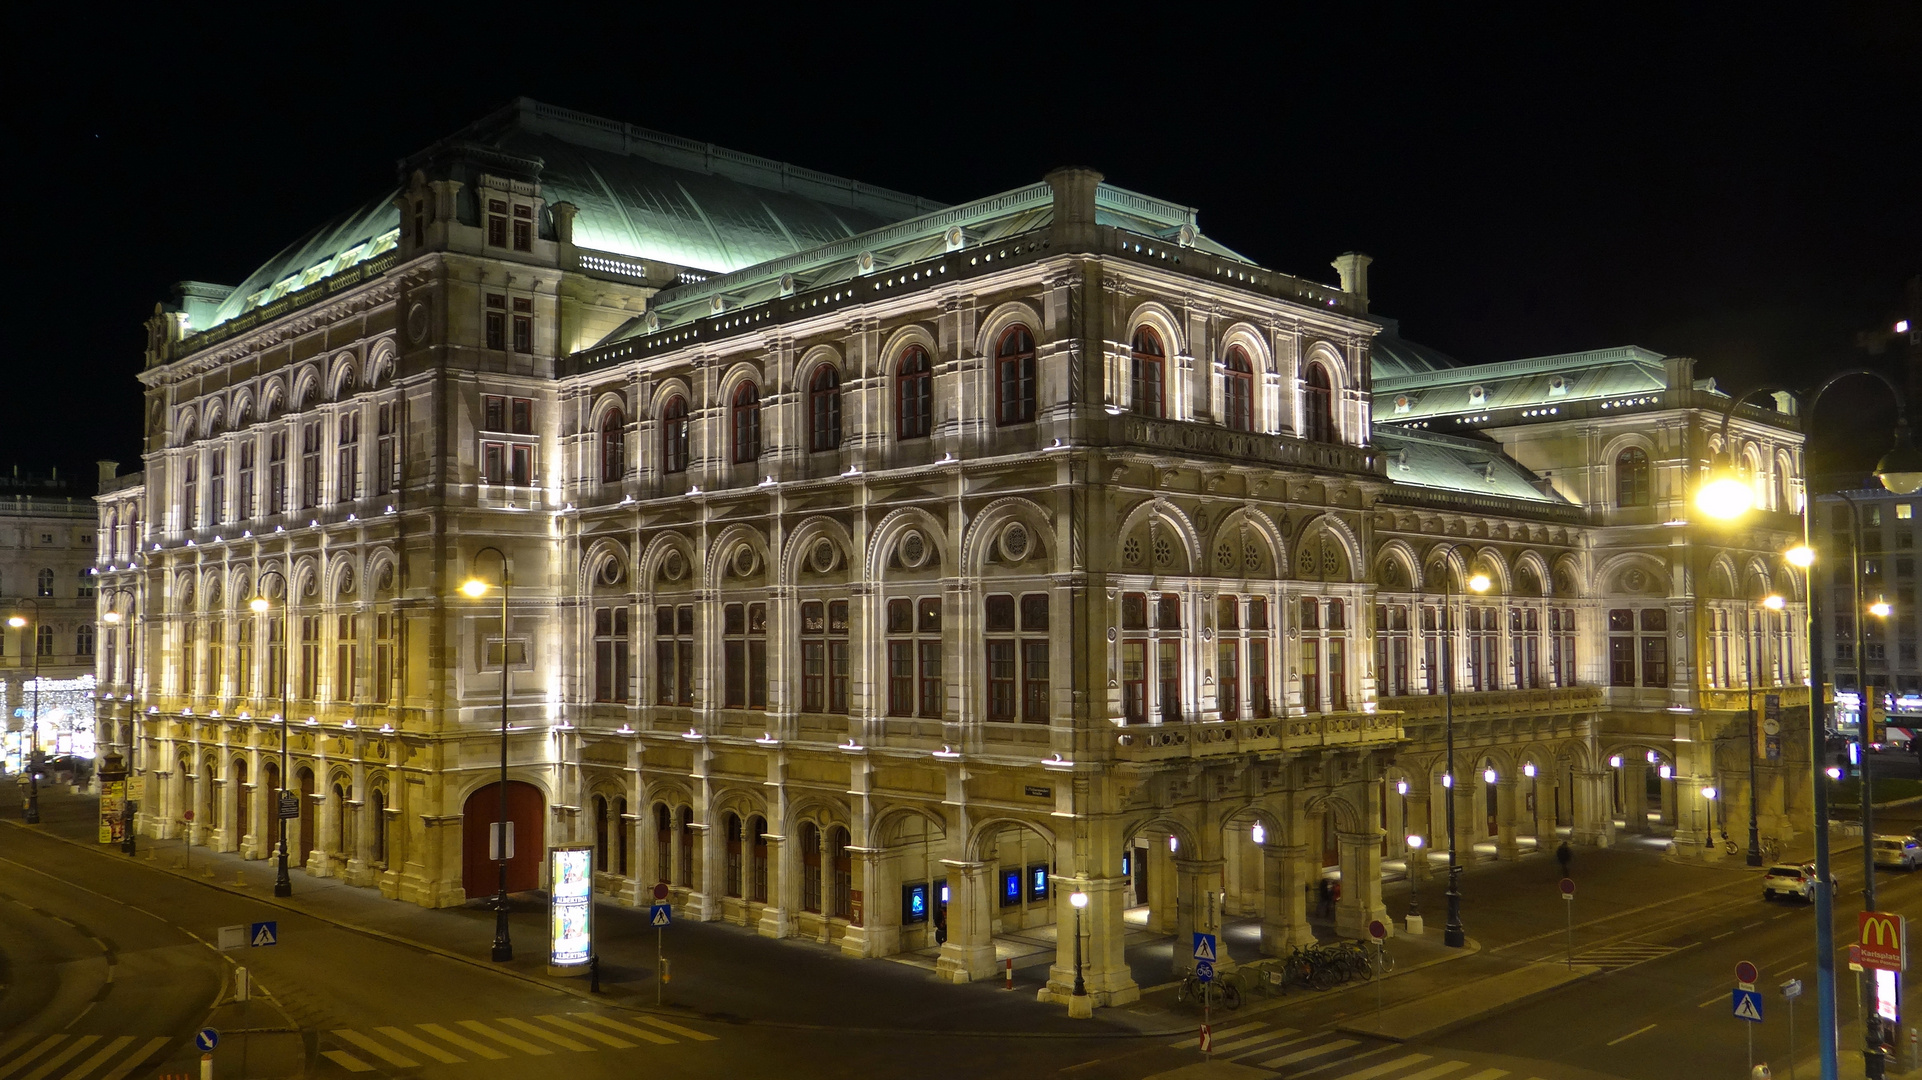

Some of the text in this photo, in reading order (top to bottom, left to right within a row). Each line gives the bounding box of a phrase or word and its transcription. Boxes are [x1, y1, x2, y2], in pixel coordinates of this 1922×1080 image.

[556, 895, 588, 903] ALBERTINA
[556, 951, 587, 959] ALBERTINA
[1861, 949, 1900, 960] Karlsplatz
